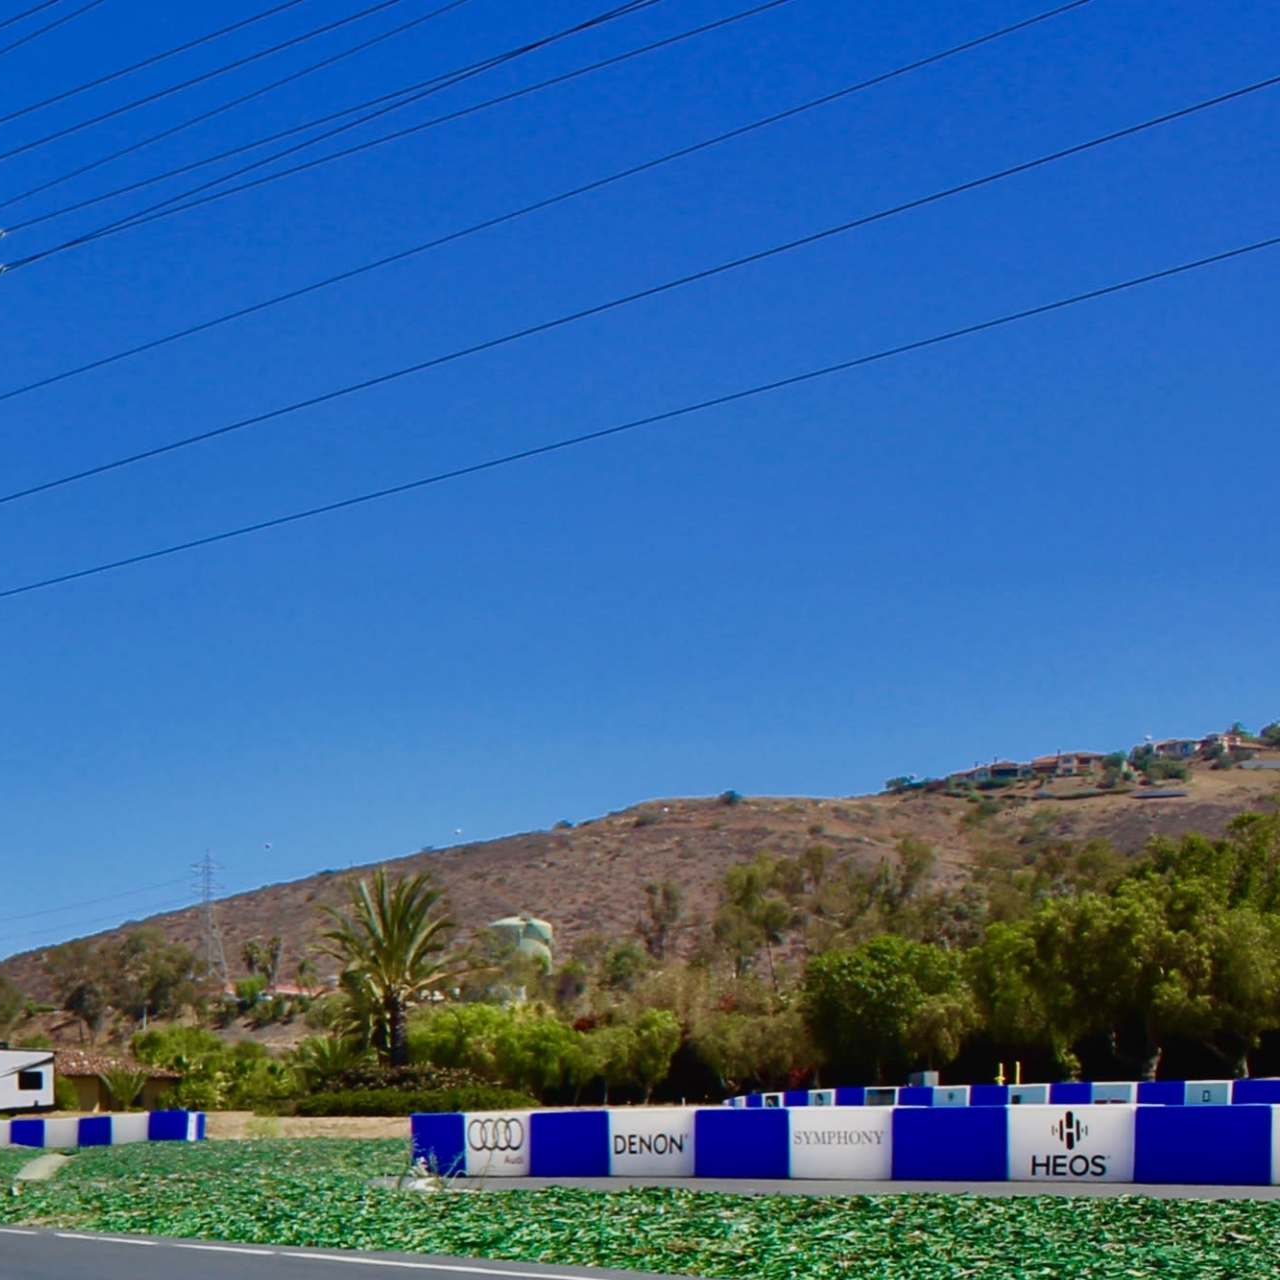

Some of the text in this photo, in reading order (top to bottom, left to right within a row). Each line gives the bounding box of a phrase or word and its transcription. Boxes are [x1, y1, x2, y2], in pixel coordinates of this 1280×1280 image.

[614, 1133, 684, 1155] DENON
[793, 1130, 884, 1145] SYMPHONY
[1031, 1154, 1107, 1177] HEOS
